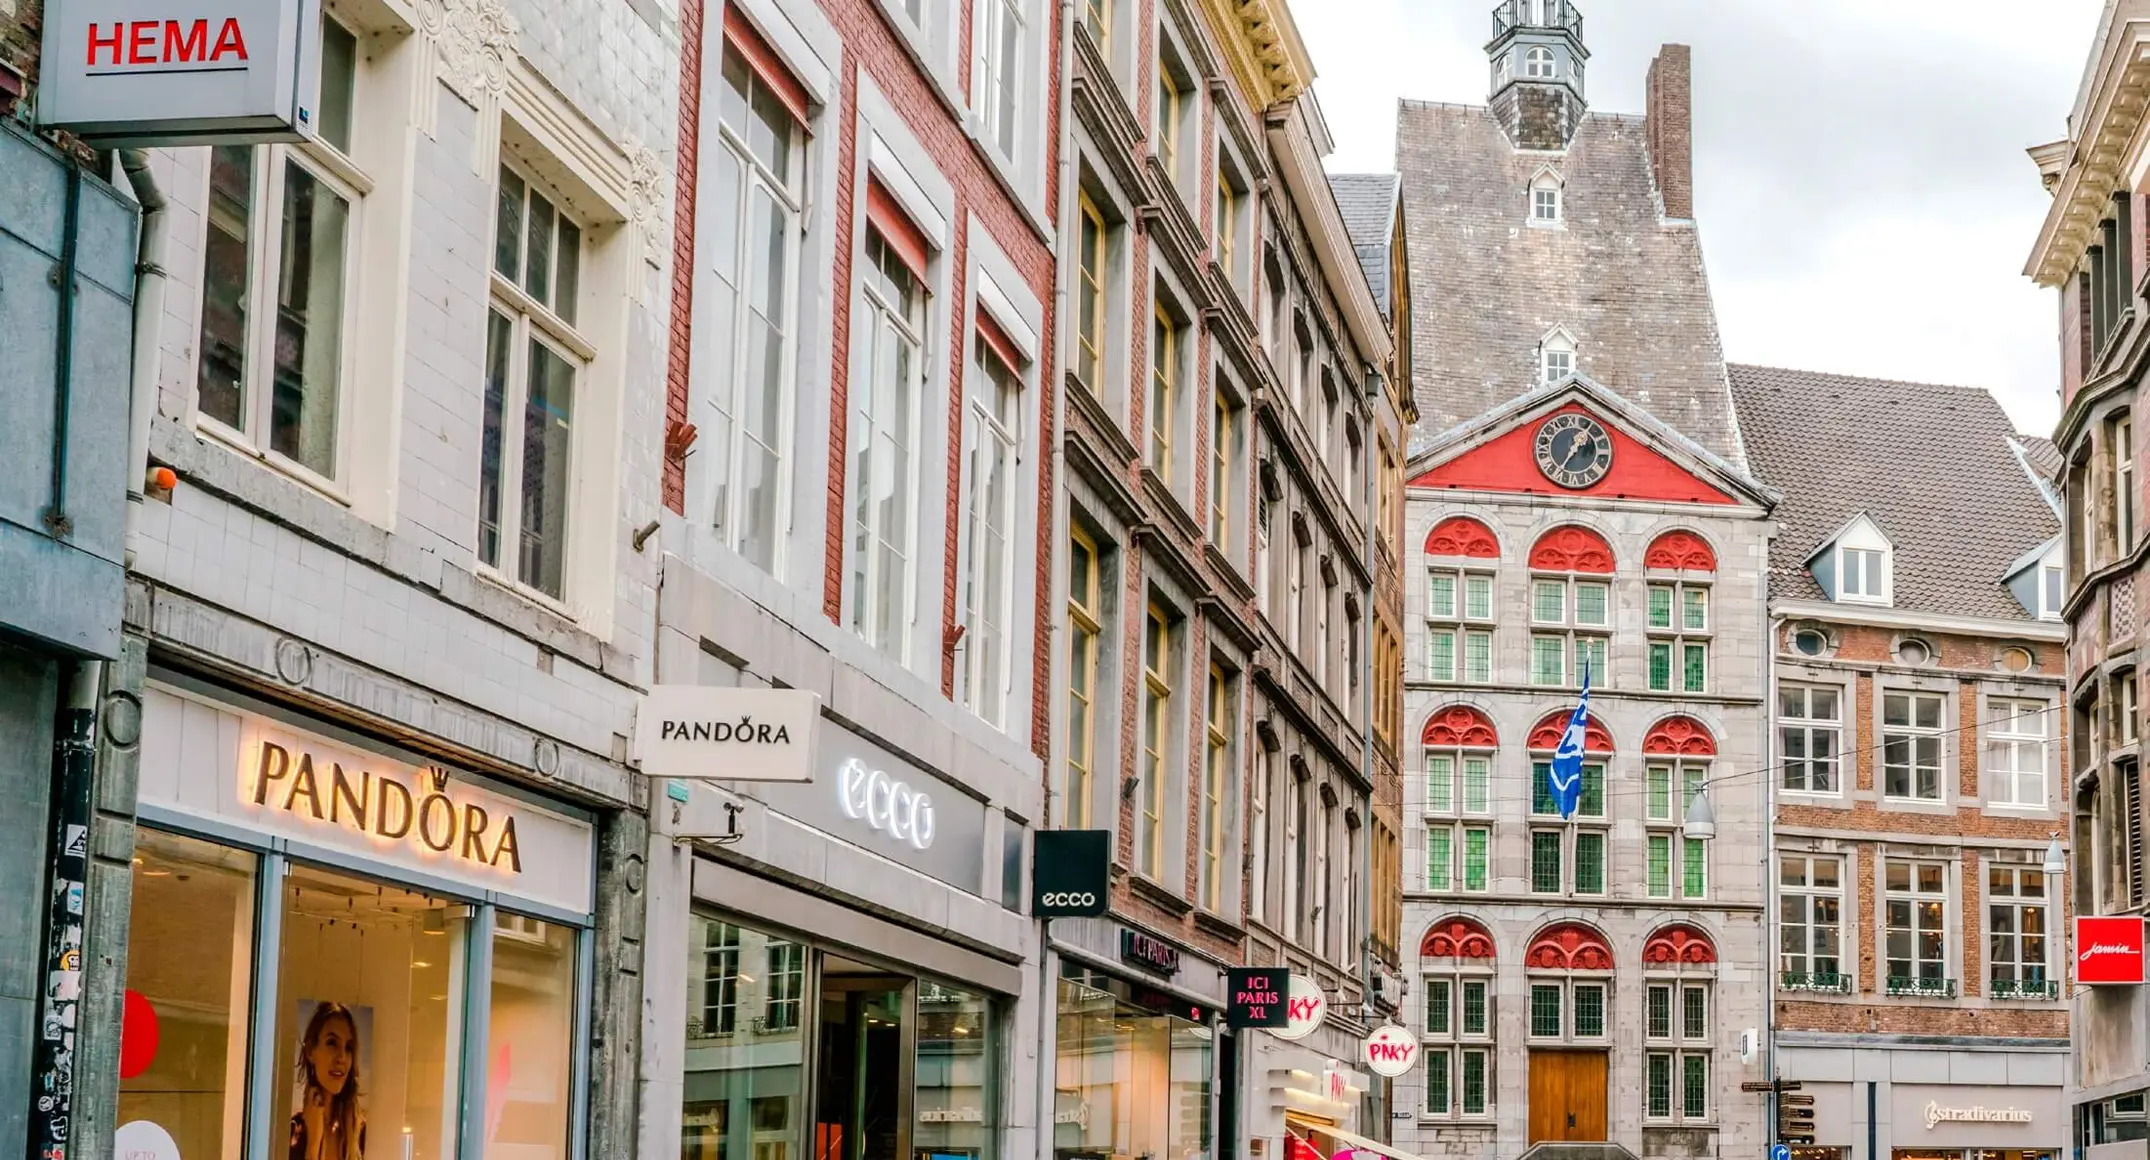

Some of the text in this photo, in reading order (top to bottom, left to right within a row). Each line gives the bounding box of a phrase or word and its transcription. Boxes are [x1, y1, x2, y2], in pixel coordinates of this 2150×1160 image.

[87, 18, 248, 65] HEMA
[661, 715, 790, 744] PANDORA
[253, 741, 522, 873] PANDORA
[840, 757, 936, 849] ecco
[1042, 892, 1095, 907] ecco
[1247, 976, 1269, 989] ICI
[1236, 991, 1279, 1005] PARIS
[1249, 1006, 1267, 1019] XL
[1930, 1104, 2032, 1123] stradivarius
